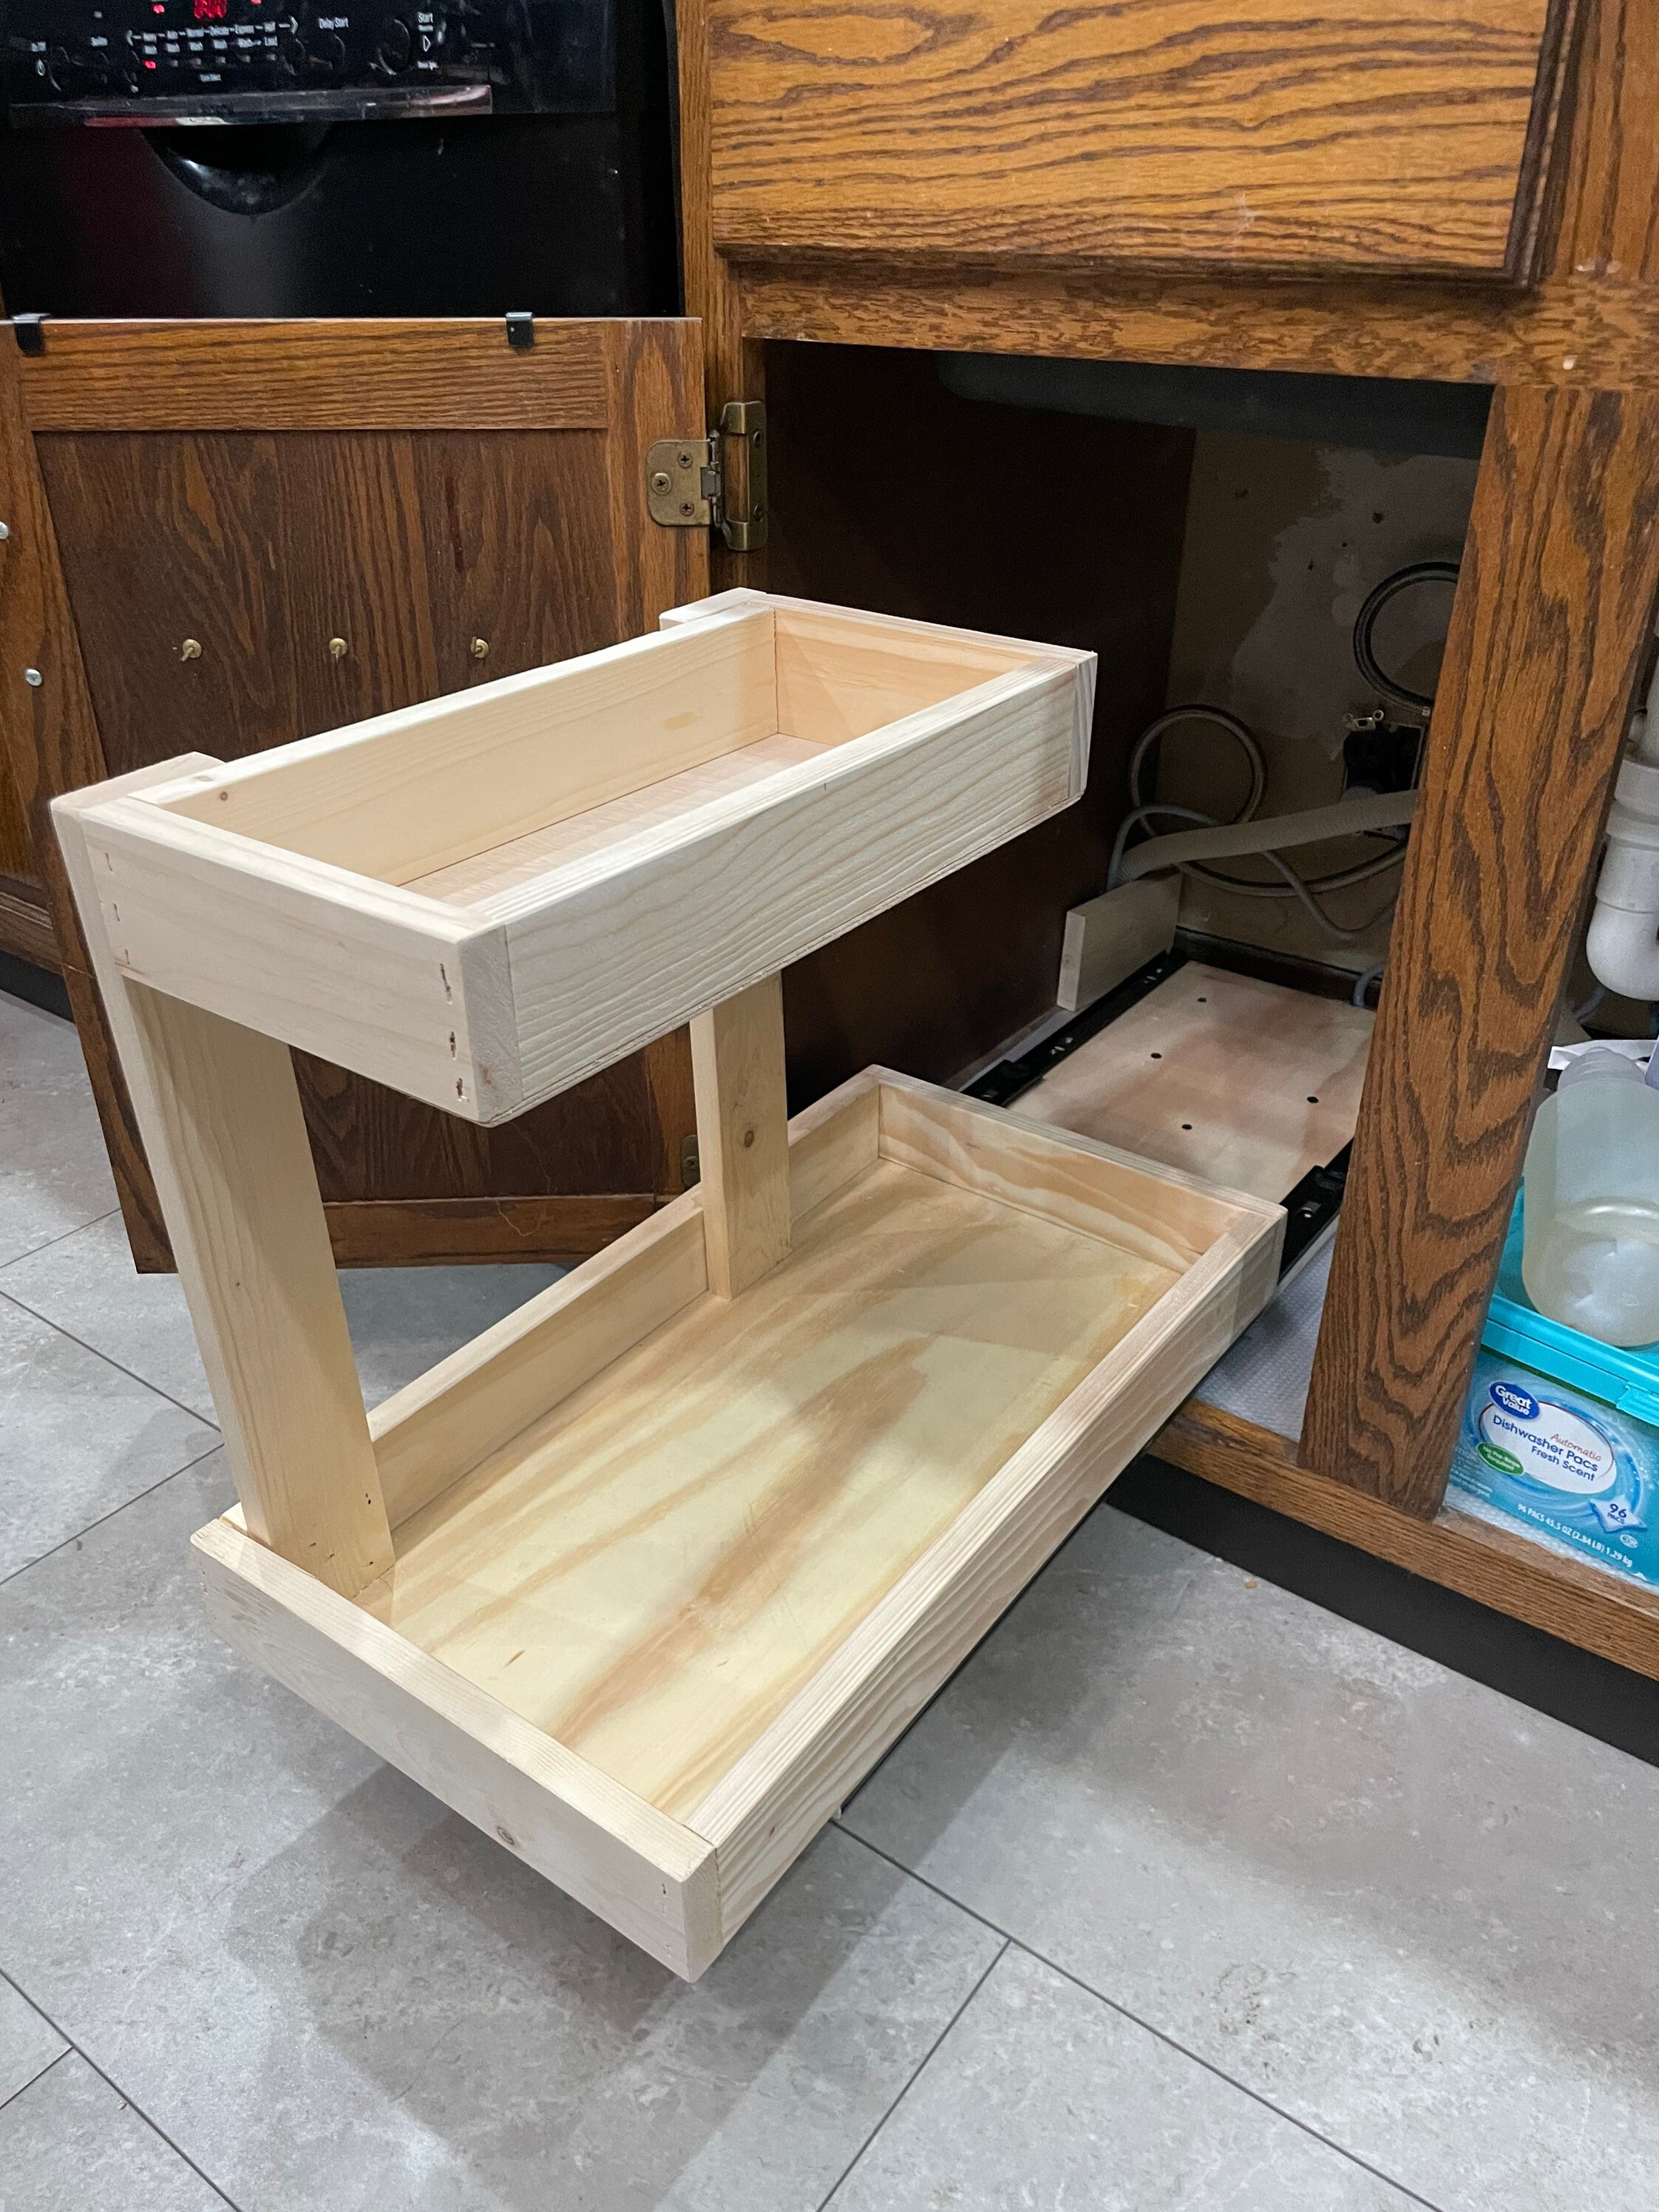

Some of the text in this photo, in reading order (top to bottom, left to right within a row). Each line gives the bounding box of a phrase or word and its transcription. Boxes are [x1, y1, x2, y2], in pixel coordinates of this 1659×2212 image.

[1495, 1385, 1532, 1410] Great
[1502, 1397, 1530, 1416] Value
[1493, 1414, 1598, 1472] Dishwasher Pacs
[1550, 1434, 1601, 1462] Automatic
[1531, 1445, 1595, 1482] Fresh Scent
[1609, 1503, 1627, 1519] 96
